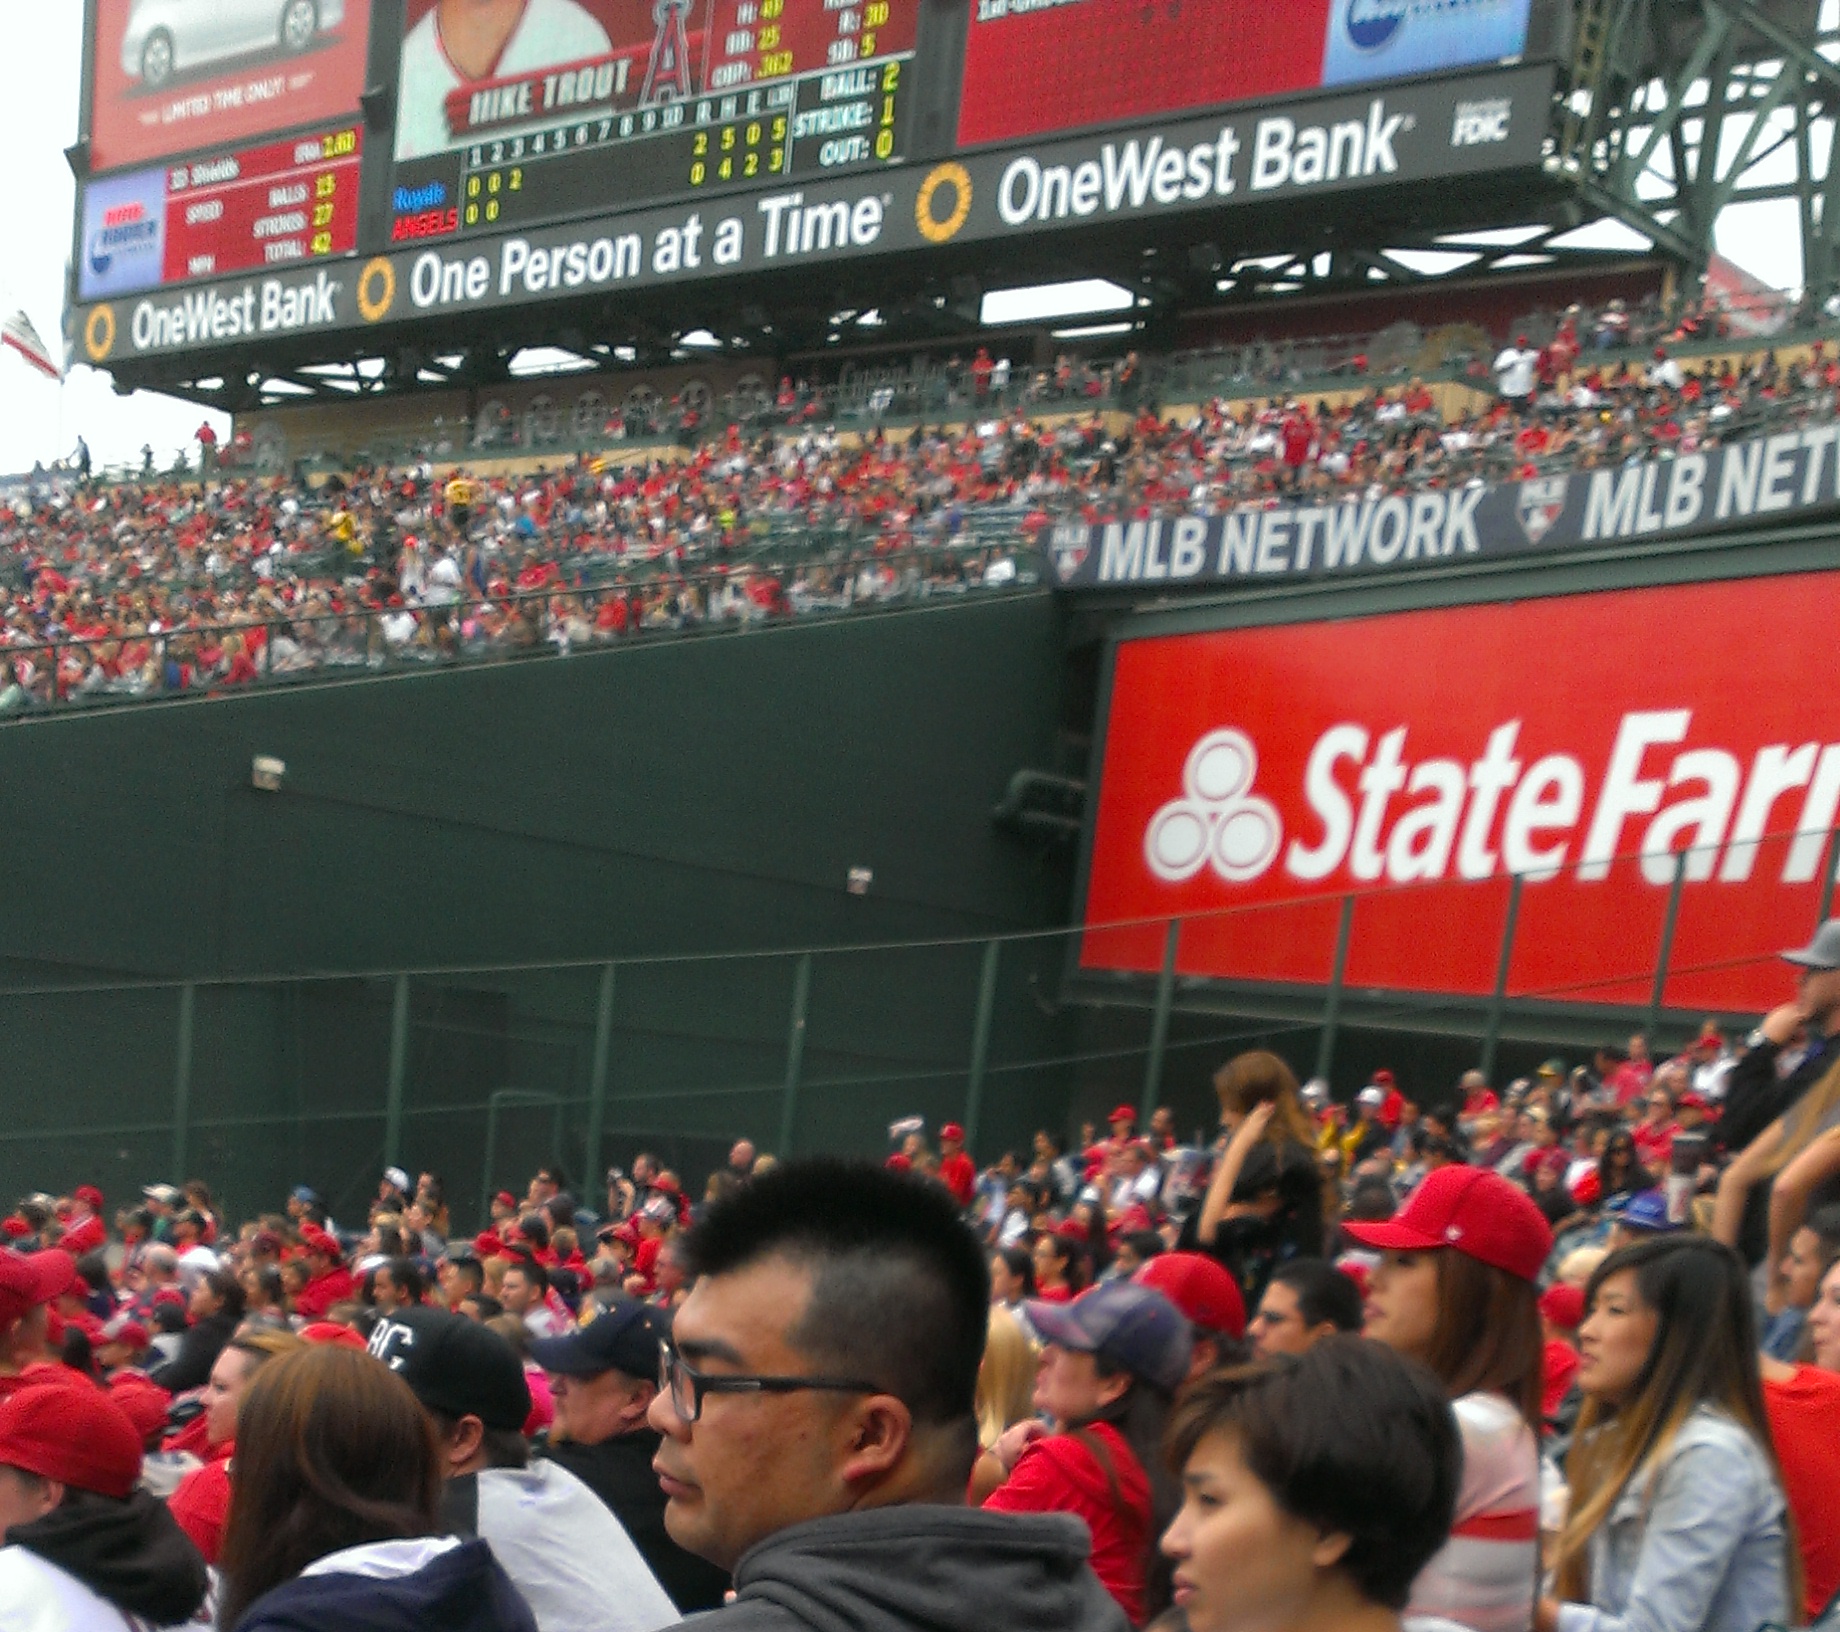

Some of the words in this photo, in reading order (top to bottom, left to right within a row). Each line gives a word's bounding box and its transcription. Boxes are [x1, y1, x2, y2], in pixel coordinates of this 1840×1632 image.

[469, 81, 533, 125] MIKE
[543, 58, 632, 109] TROUT
[793, 102, 873, 138] STRIKE:
[880, 95, 894, 126] 1
[882, 61, 900, 93] 2
[468, 176, 481, 198] 0
[488, 171, 501, 193] 0
[509, 167, 522, 191] 2
[693, 132, 708, 156] 2
[746, 122, 761, 146] 0
[820, 135, 870, 166] OUT:
[875, 128, 894, 159] 0
[997, 127, 1240, 226] OneWest
[1250, 100, 1402, 190] Bank
[391, 207, 458, 240] ANGELS
[466, 203, 479, 225] 0
[485, 199, 499, 221] 0
[690, 162, 706, 185] 0
[718, 157, 733, 180] 4
[744, 153, 758, 176] 2
[411, 251, 489, 307] One
[501, 231, 641, 295] Person
[653, 215, 702, 275] at
[713, 218, 743, 265] a
[758, 192, 883, 257] Time
[132, 286, 254, 350] OneWest
[261, 269, 335, 331] Bank
[1581, 455, 1706, 539] MLB
[1714, 425, 1840, 518] NET
[1097, 517, 1207, 582] MLB
[1218, 485, 1485, 575] NETWORK
